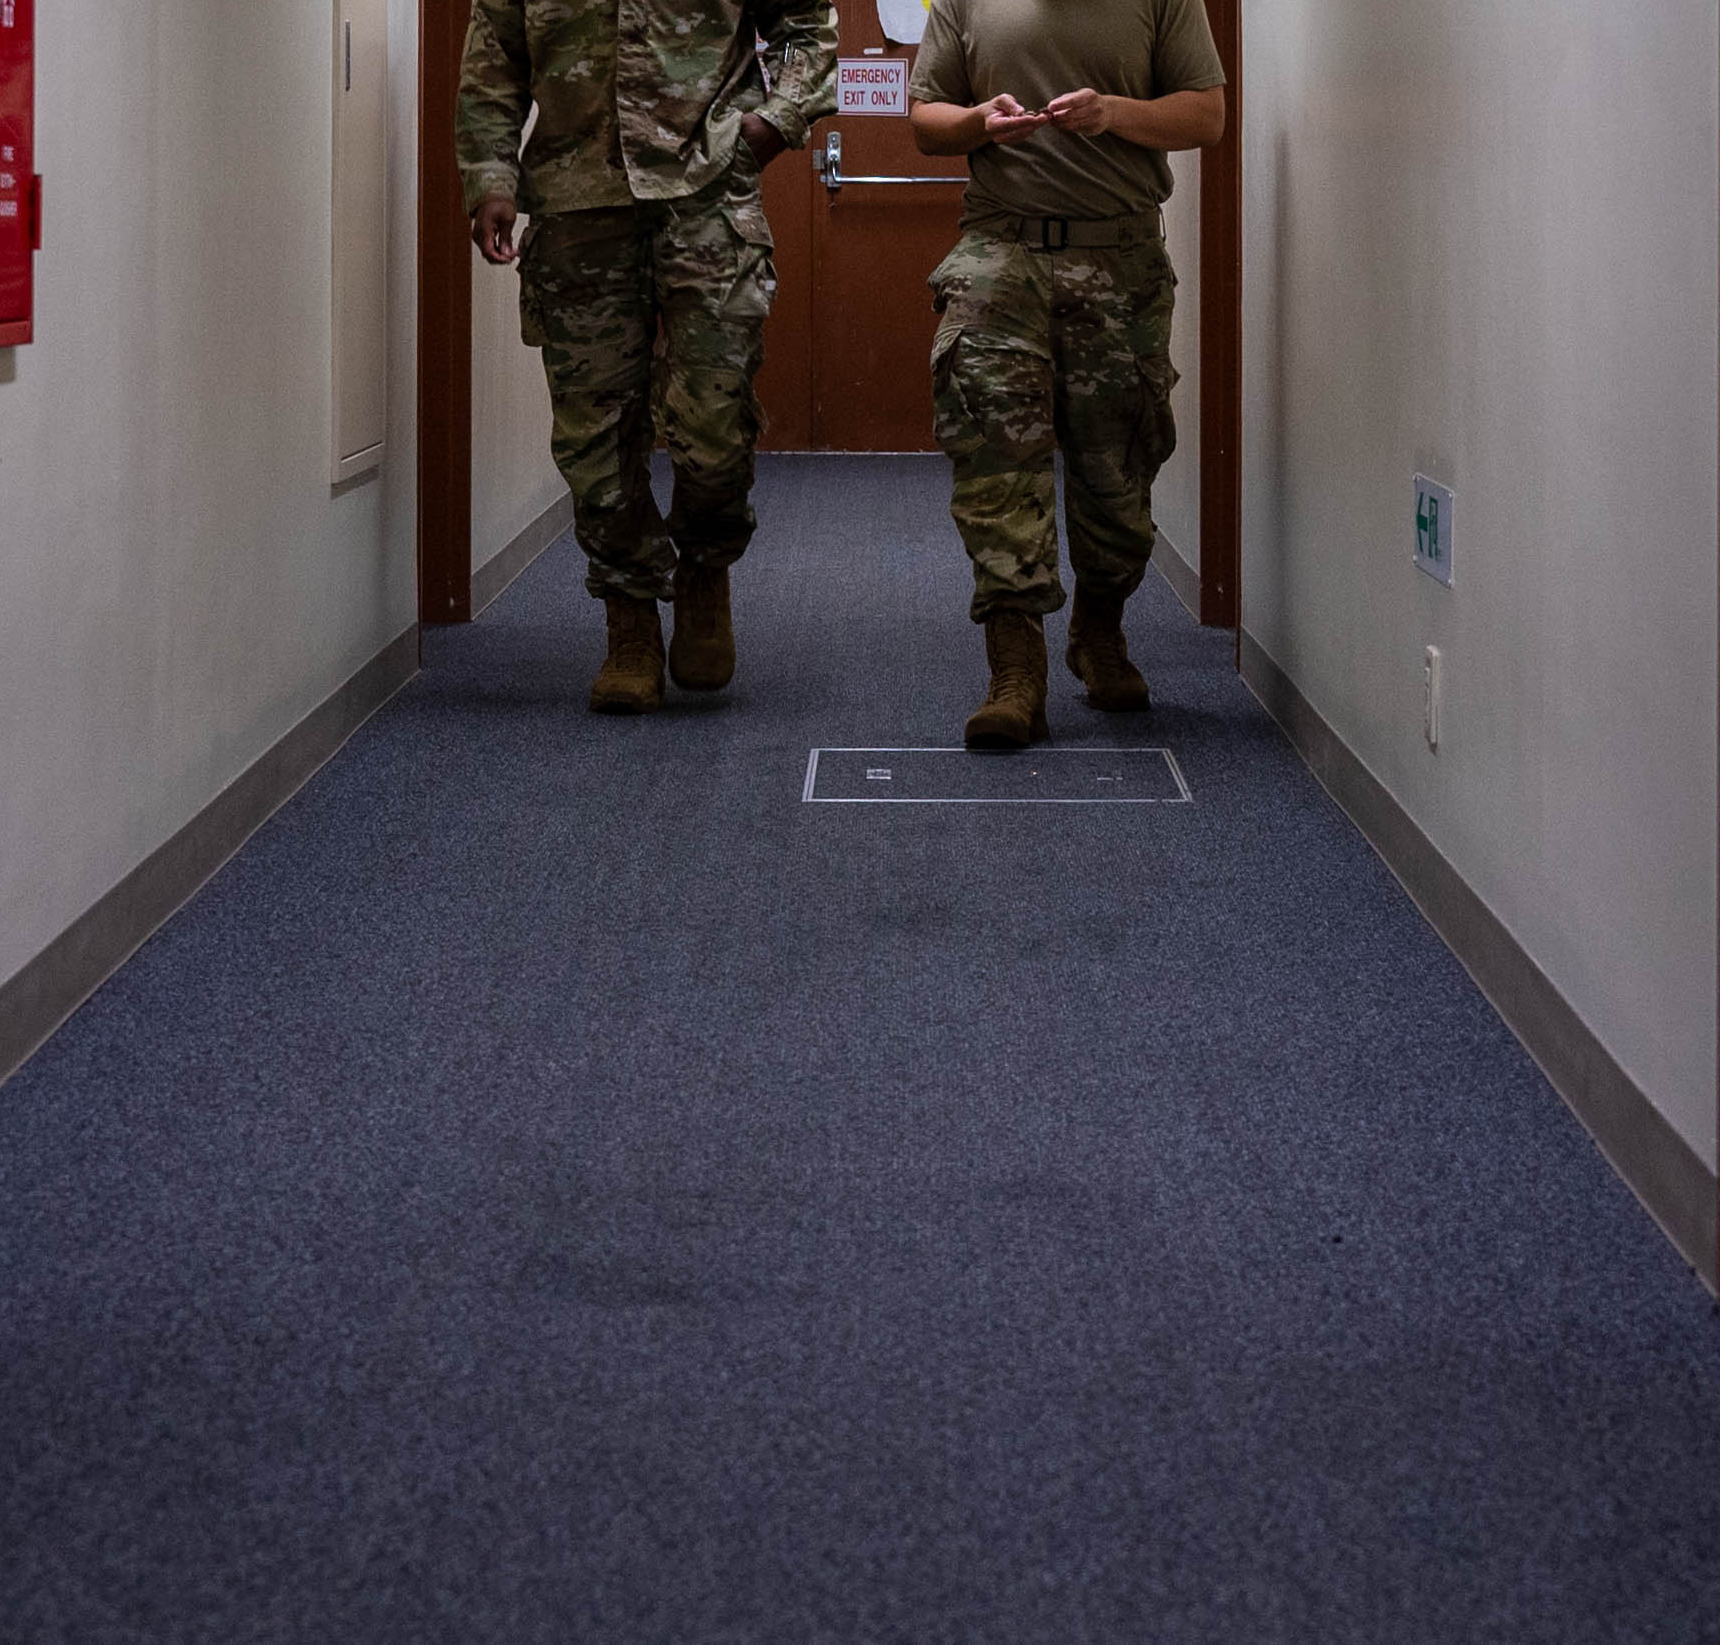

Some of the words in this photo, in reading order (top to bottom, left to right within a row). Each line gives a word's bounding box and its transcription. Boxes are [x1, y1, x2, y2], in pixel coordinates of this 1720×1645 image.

[841, 68, 901, 84] EMERGENCY
[844, 91, 865, 106] EXIT
[871, 91, 898, 106] ONLY
